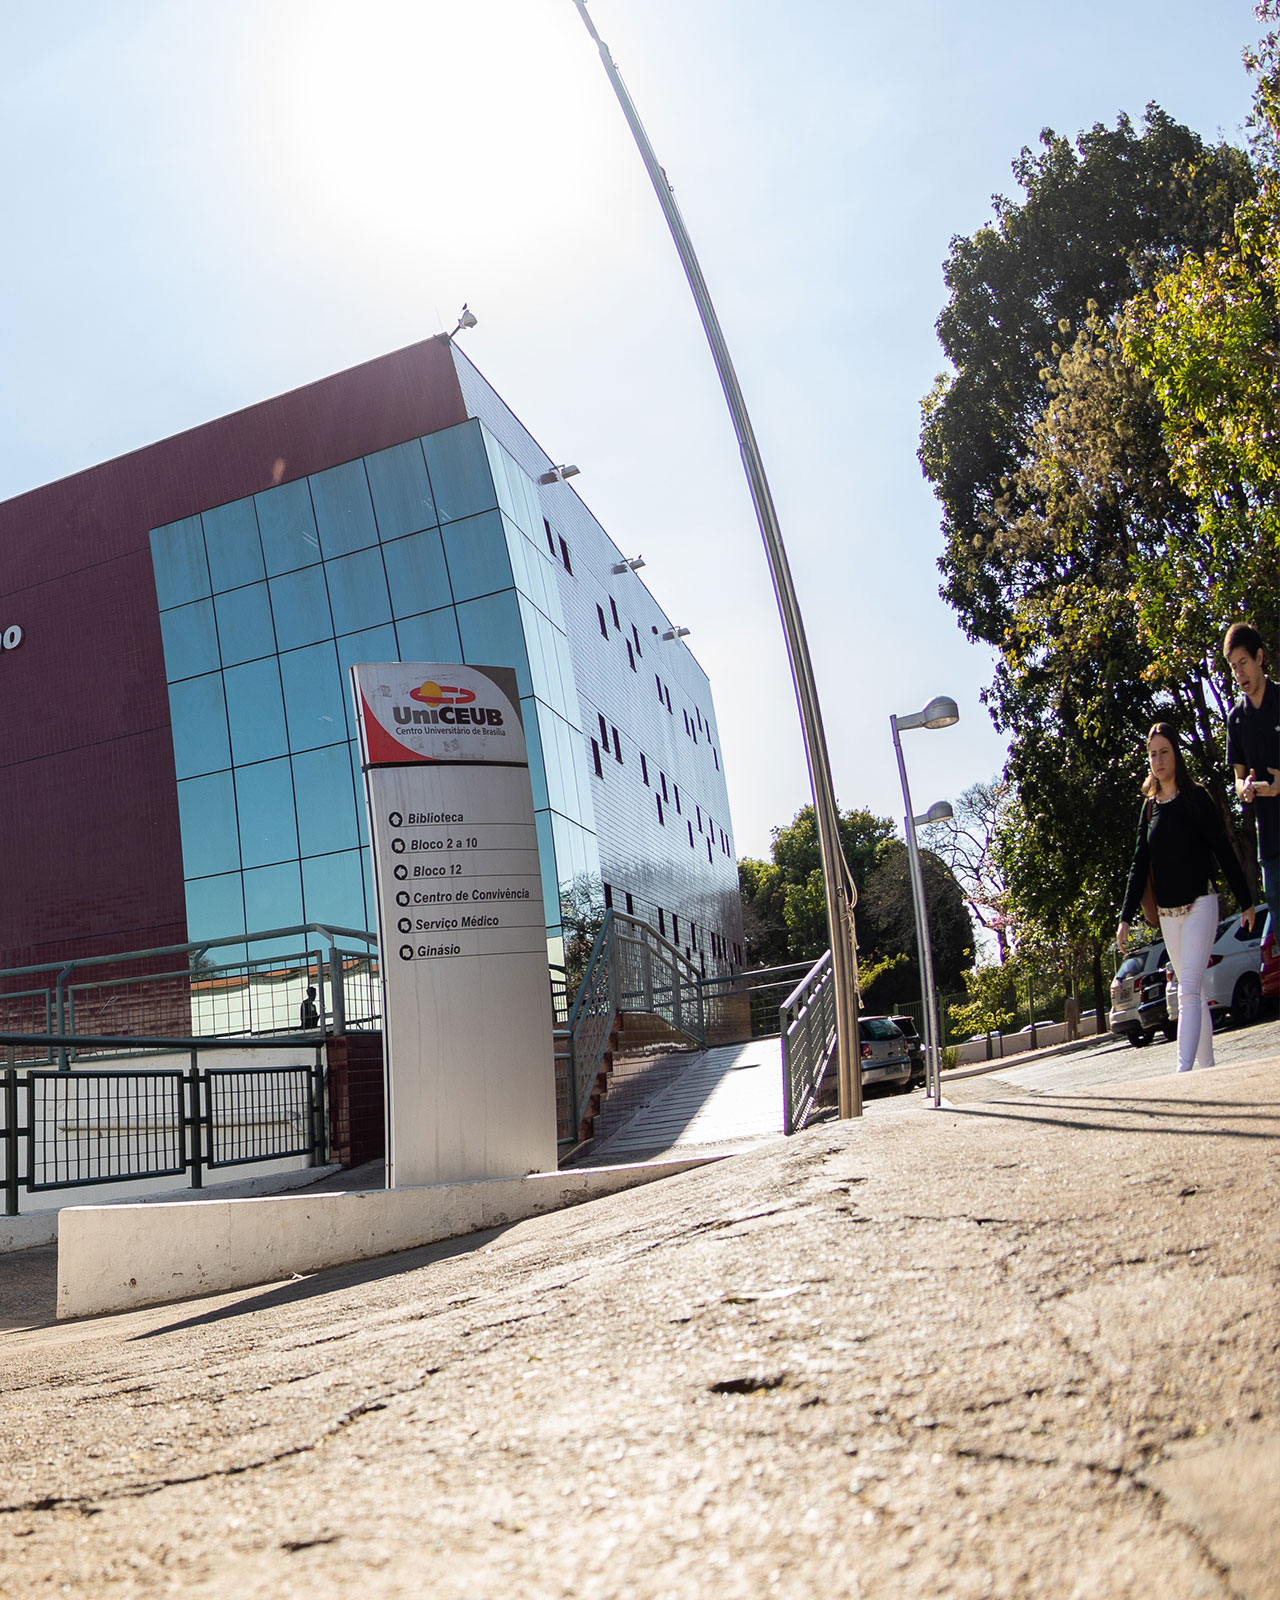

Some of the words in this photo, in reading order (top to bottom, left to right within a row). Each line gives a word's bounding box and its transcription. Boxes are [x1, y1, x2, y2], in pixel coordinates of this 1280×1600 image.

[392, 706, 504, 726] UniCEUB
[395, 727, 423, 735] Centro
[425, 726, 471, 735] Universitário
[472, 727, 481, 735] de
[482, 728, 506, 736] Brasília
[408, 812, 464, 824] Biblioteca
[411, 839, 443, 850] Bloco
[446, 838, 453, 849] 2
[456, 840, 462, 848] a
[465, 837, 478, 848] 10
[413, 865, 446, 877] Bloco
[449, 864, 462, 875] 12
[413, 892, 452, 903] Centro
[455, 890, 469, 901] de
[471, 888, 530, 901] Convivência
[415, 918, 458, 931] Serviço
[461, 915, 499, 927] Médico
[417, 944, 461, 957] Ginásio
